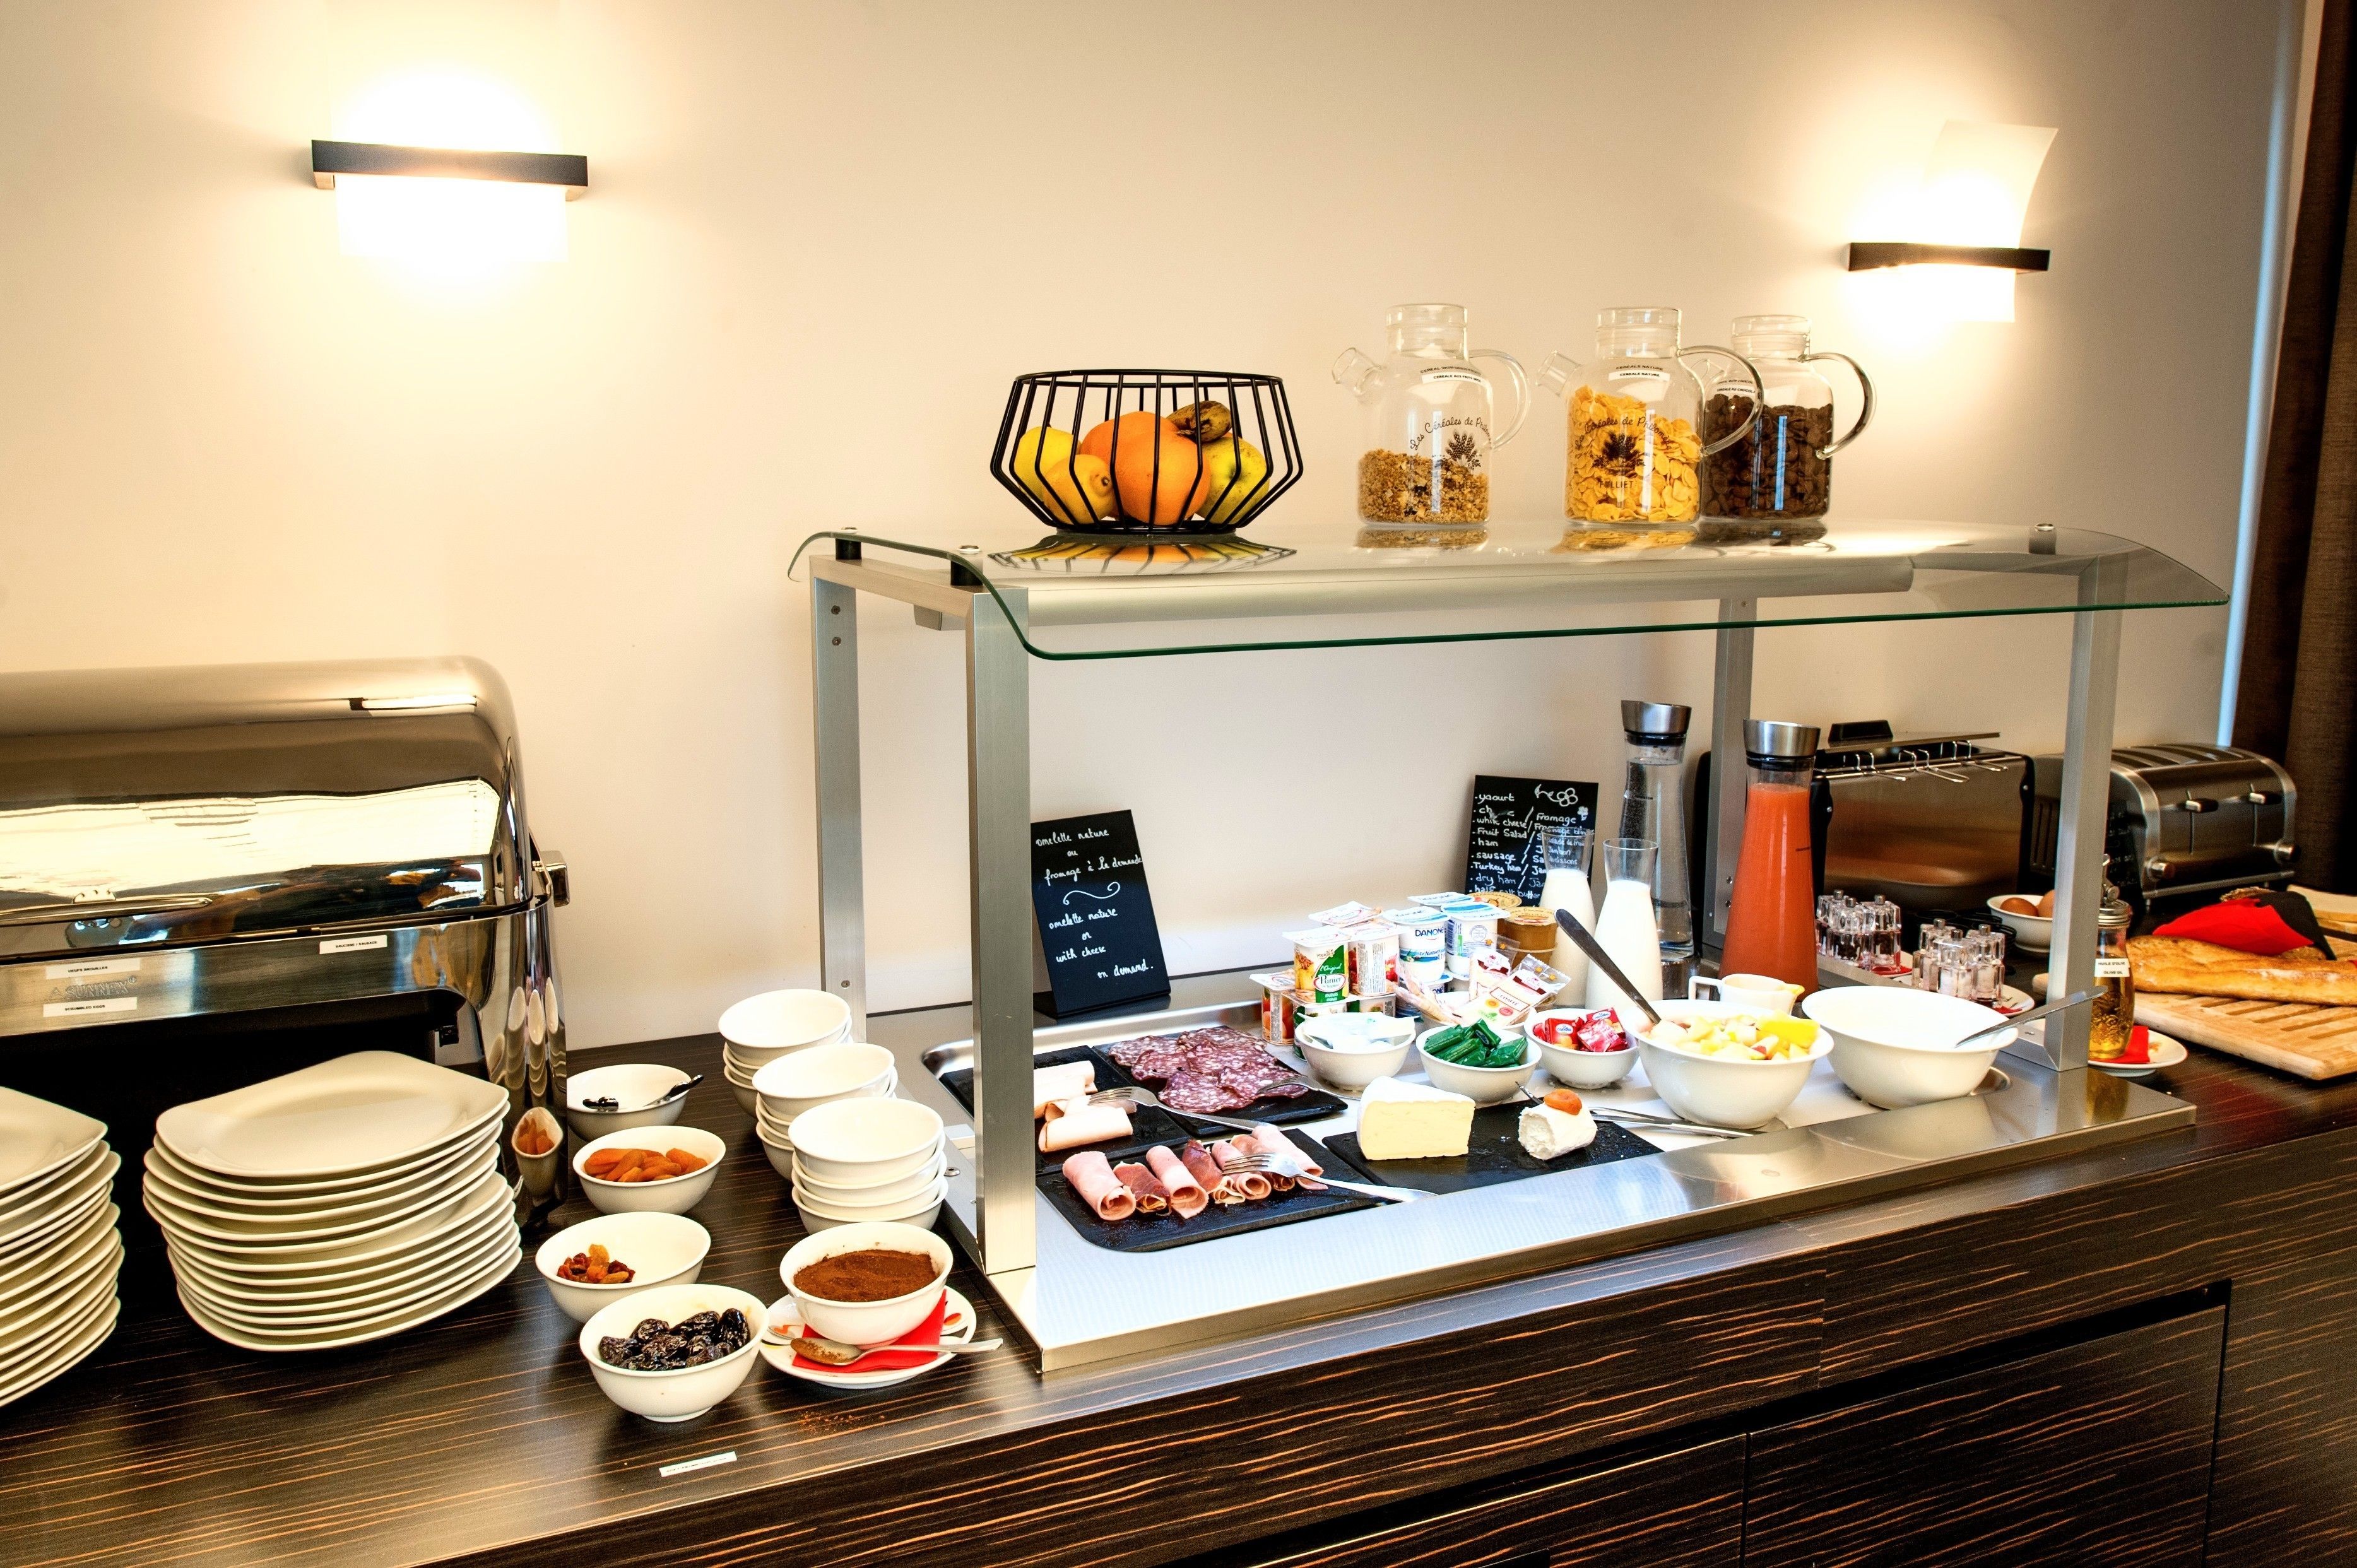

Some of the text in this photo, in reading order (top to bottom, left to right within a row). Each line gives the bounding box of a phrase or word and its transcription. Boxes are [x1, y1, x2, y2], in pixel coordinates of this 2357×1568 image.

[1464, 416, 1474, 426] de
[1622, 417, 1633, 425] de
[1477, 793, 1515, 805] yaourt
[1536, 813, 1576, 827] Fromage
[1036, 828, 1109, 847] omelette nature
[1477, 827, 1499, 836] Fruit
[1503, 829, 1527, 839] Salad
[1478, 837, 1499, 847] ham
[1476, 852, 1516, 864] sausage
[1472, 861, 1504, 875] Turkey
[1044, 868, 1082, 887] fromage
[1475, 873, 1494, 886] dry
[1497, 875, 1516, 884] ham
[1049, 908, 1118, 929] omelette nature
[1056, 947, 1077, 963] with
[1320, 975, 1342, 984] Panier
